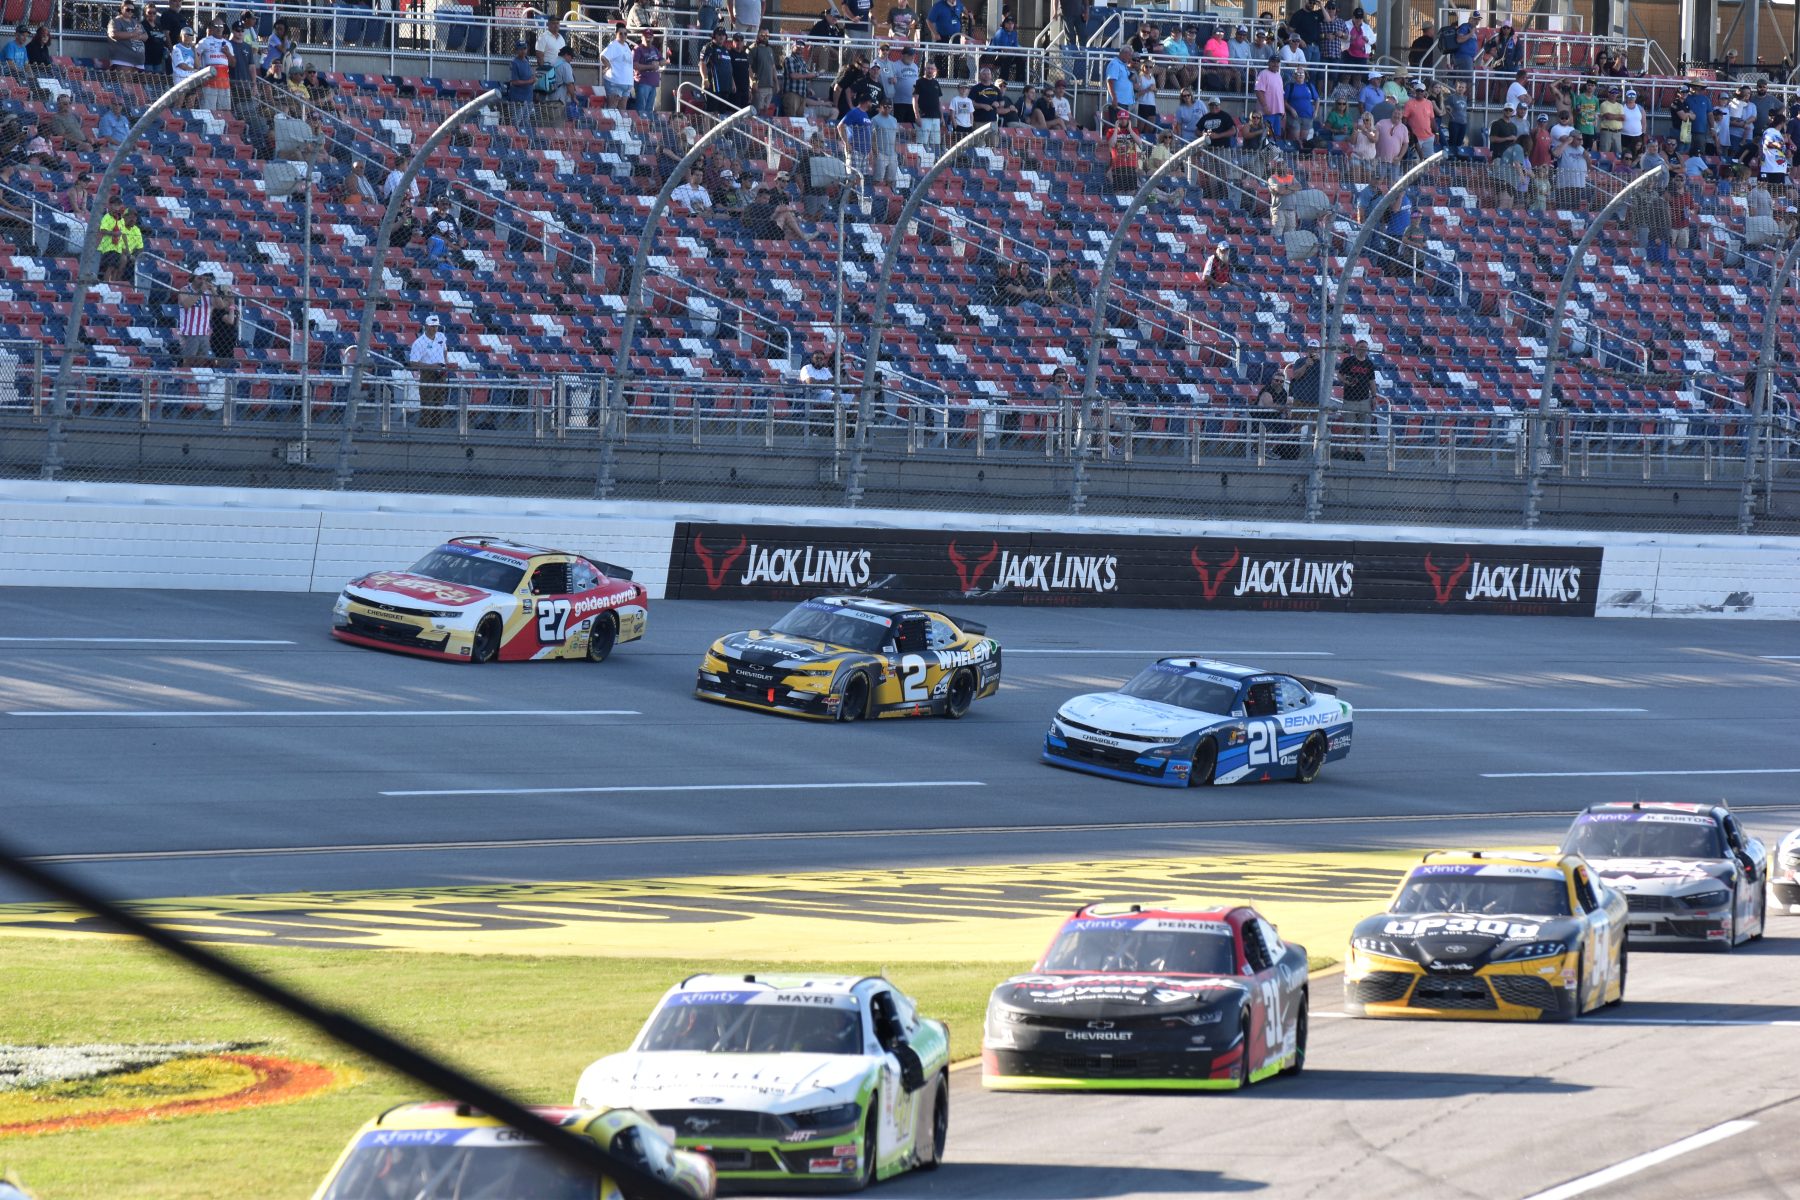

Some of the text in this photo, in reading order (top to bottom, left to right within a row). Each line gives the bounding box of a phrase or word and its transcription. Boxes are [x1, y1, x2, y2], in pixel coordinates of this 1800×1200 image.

[492, 554, 523, 566] BURTON
[741, 544, 871, 587] JACK LINK'S
[992, 551, 1117, 592] JACK LINK'S
[1234, 556, 1354, 597] JACK LINK'S
[1465, 562, 1581, 602] JACK LINK'S
[574, 587, 637, 617] golden corral
[367, 609, 404, 620] CHEVROLET
[538, 599, 572, 641] 27
[856, 611, 876, 620] LOVE
[933, 640, 990, 671] WHELEN
[735, 669, 773, 681] CHEVROLET
[902, 654, 928, 701] 2
[1208, 675, 1223, 683] HILL
[1284, 711, 1340, 728] BENNETT
[1082, 734, 1120, 746] CHEVROLET
[1248, 720, 1279, 766] 21
[1588, 813, 1632, 823] xfinity
[1663, 815, 1712, 824] BURTON
[1422, 865, 1471, 875] xfinity
[1075, 919, 1128, 931] xfinity
[681, 992, 835, 1005] xfinity MAYER
[1262, 978, 1283, 1049] 31
[1065, 1031, 1133, 1040] CHEVROLET
[374, 1130, 448, 1145] xfinity
